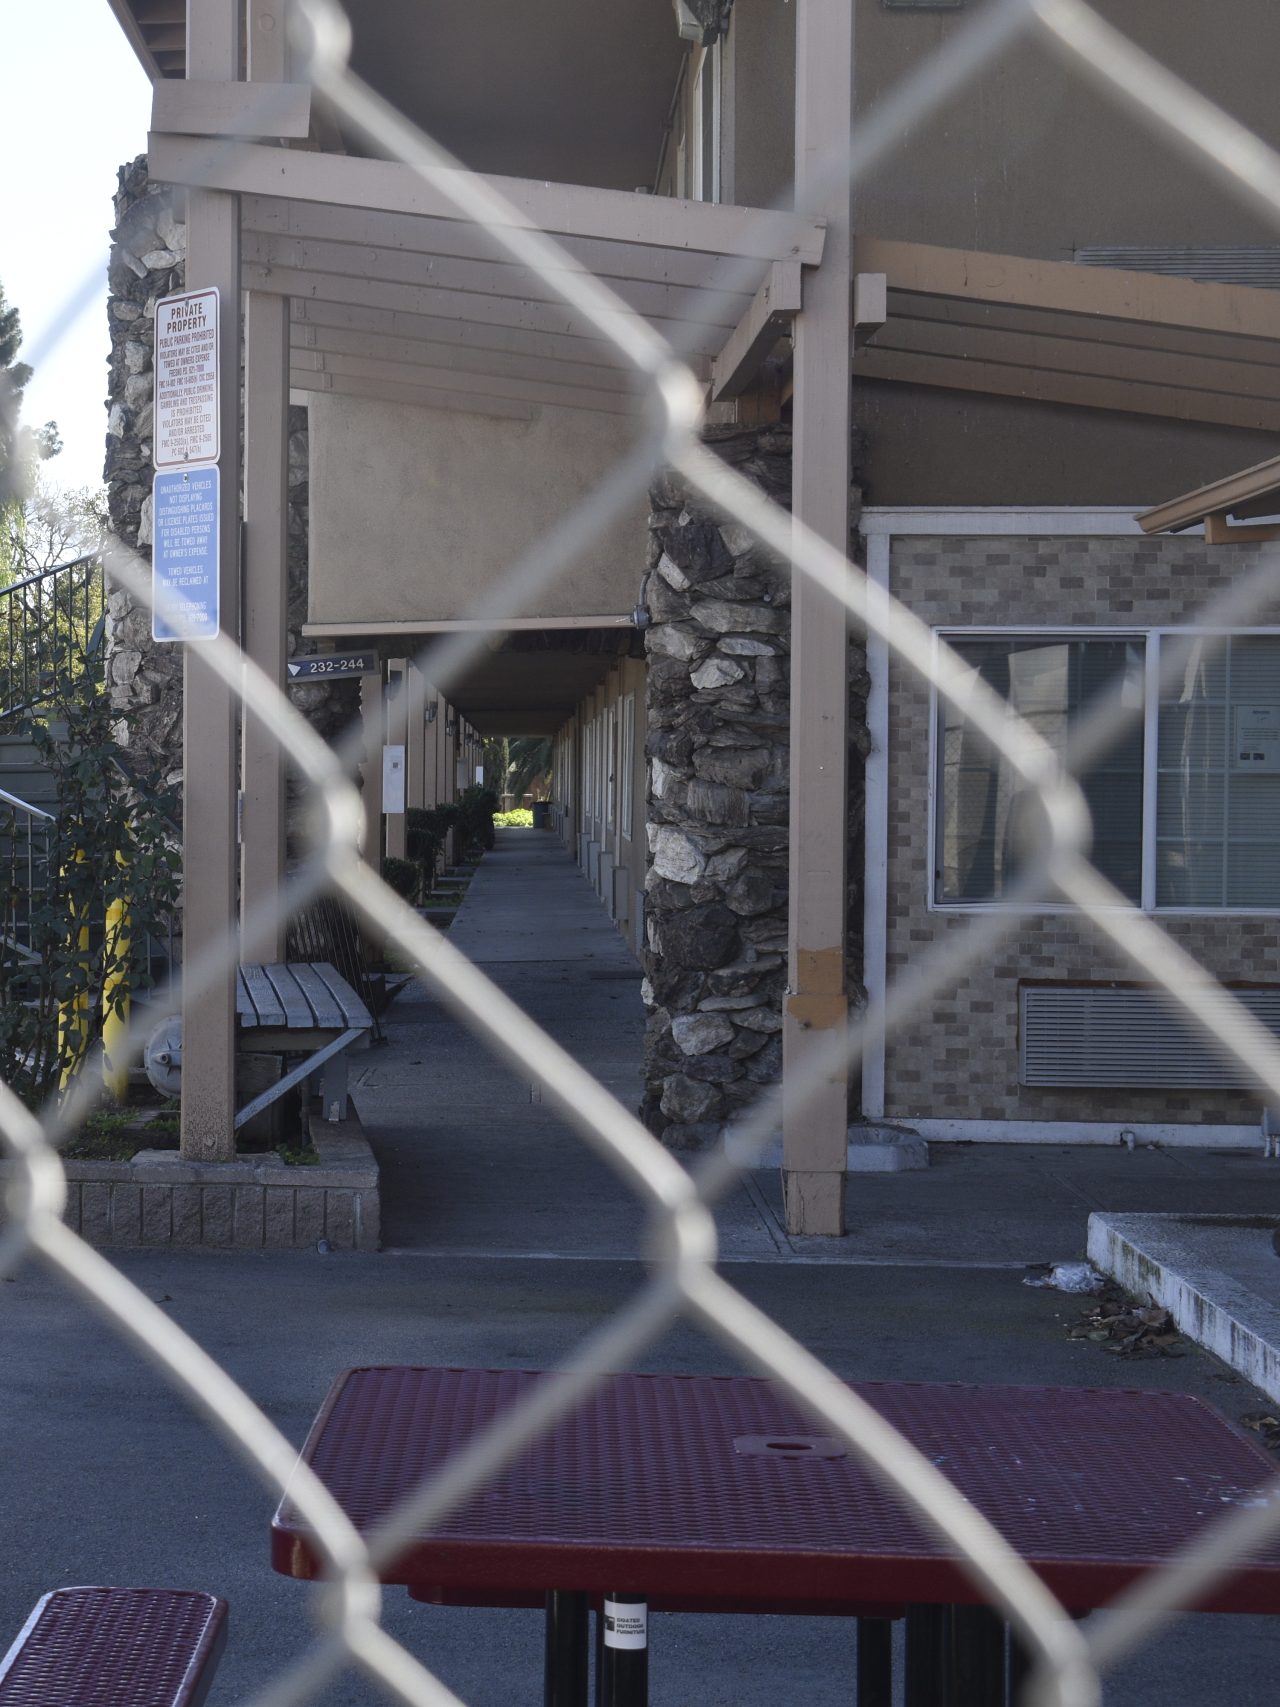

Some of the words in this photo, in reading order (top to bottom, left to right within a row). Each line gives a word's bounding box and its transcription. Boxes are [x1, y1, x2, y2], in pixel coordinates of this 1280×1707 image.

[172, 303, 202, 319] PRIVATE
[167, 315, 206, 333] PROPERTY
[160, 337, 173, 348] PUBLIC
[174, 333, 190, 345] PARKING
[192, 329, 214, 342] PROHIBITED
[186, 346, 190, 354] BE
[164, 359, 175, 368] TOWED
[176, 358, 180, 366] AT
[184, 387, 196, 396] PUBLIC
[171, 409, 175, 417] IS
[177, 406, 202, 416] PROHIBITED
[162, 419, 183, 428] VIOLATORS
[200, 414, 211, 422] CITED
[185, 425, 204, 434] ARRESTED
[161, 483, 190, 494] UNAUTHORIZED
[192, 481, 211, 490] VEHICLES
[179, 493, 202, 503] DISPLAYING
[191, 502, 213, 513] PLACARDS
[158, 519, 163, 527] OR
[164, 516, 181, 526] LICENSE
[183, 514, 198, 525] PLATES
[199, 513, 214, 522] ISSUED
[161, 528, 169, 536] FOR
[171, 526, 190, 536] DISABLED
[192, 525, 210, 534] PERSONS
[164, 539, 173, 547] WILL
[175, 538, 180, 546] BE
[182, 537, 195, 546] TOWED
[197, 536, 208, 544] AWAY
[163, 550, 169, 558] AT
[168, 567, 182, 576] TOWED
[183, 566, 203, 574] VEHICLES
[179, 577, 202, 586] RECLAIMED
[203, 576, 209, 584] AT
[310, 658, 364, 673] 232-244
